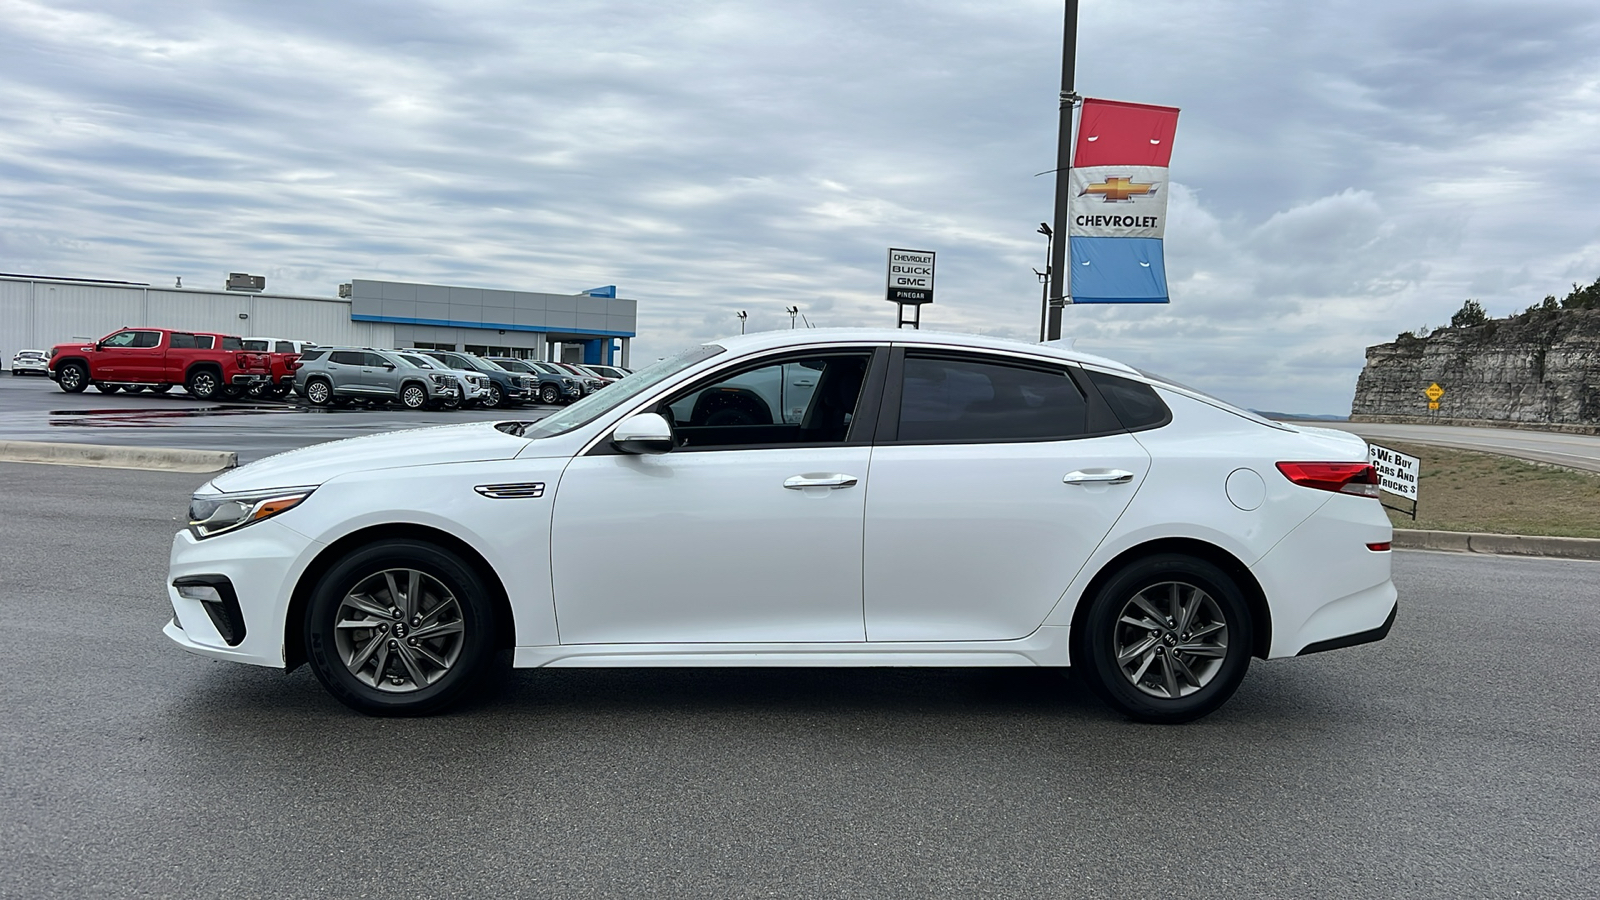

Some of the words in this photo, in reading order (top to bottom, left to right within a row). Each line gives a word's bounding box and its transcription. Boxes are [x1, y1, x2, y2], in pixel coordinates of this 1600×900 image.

[1076, 215, 1157, 228] CHEVROLET
[893, 254, 932, 264] CHEVROLET
[892, 265, 931, 275] BUICK
[897, 277, 926, 287] GMC
[896, 291, 925, 299] PINEGAR
[395, 623, 404, 638] KIA
[1164, 633, 1176, 646] KIA
